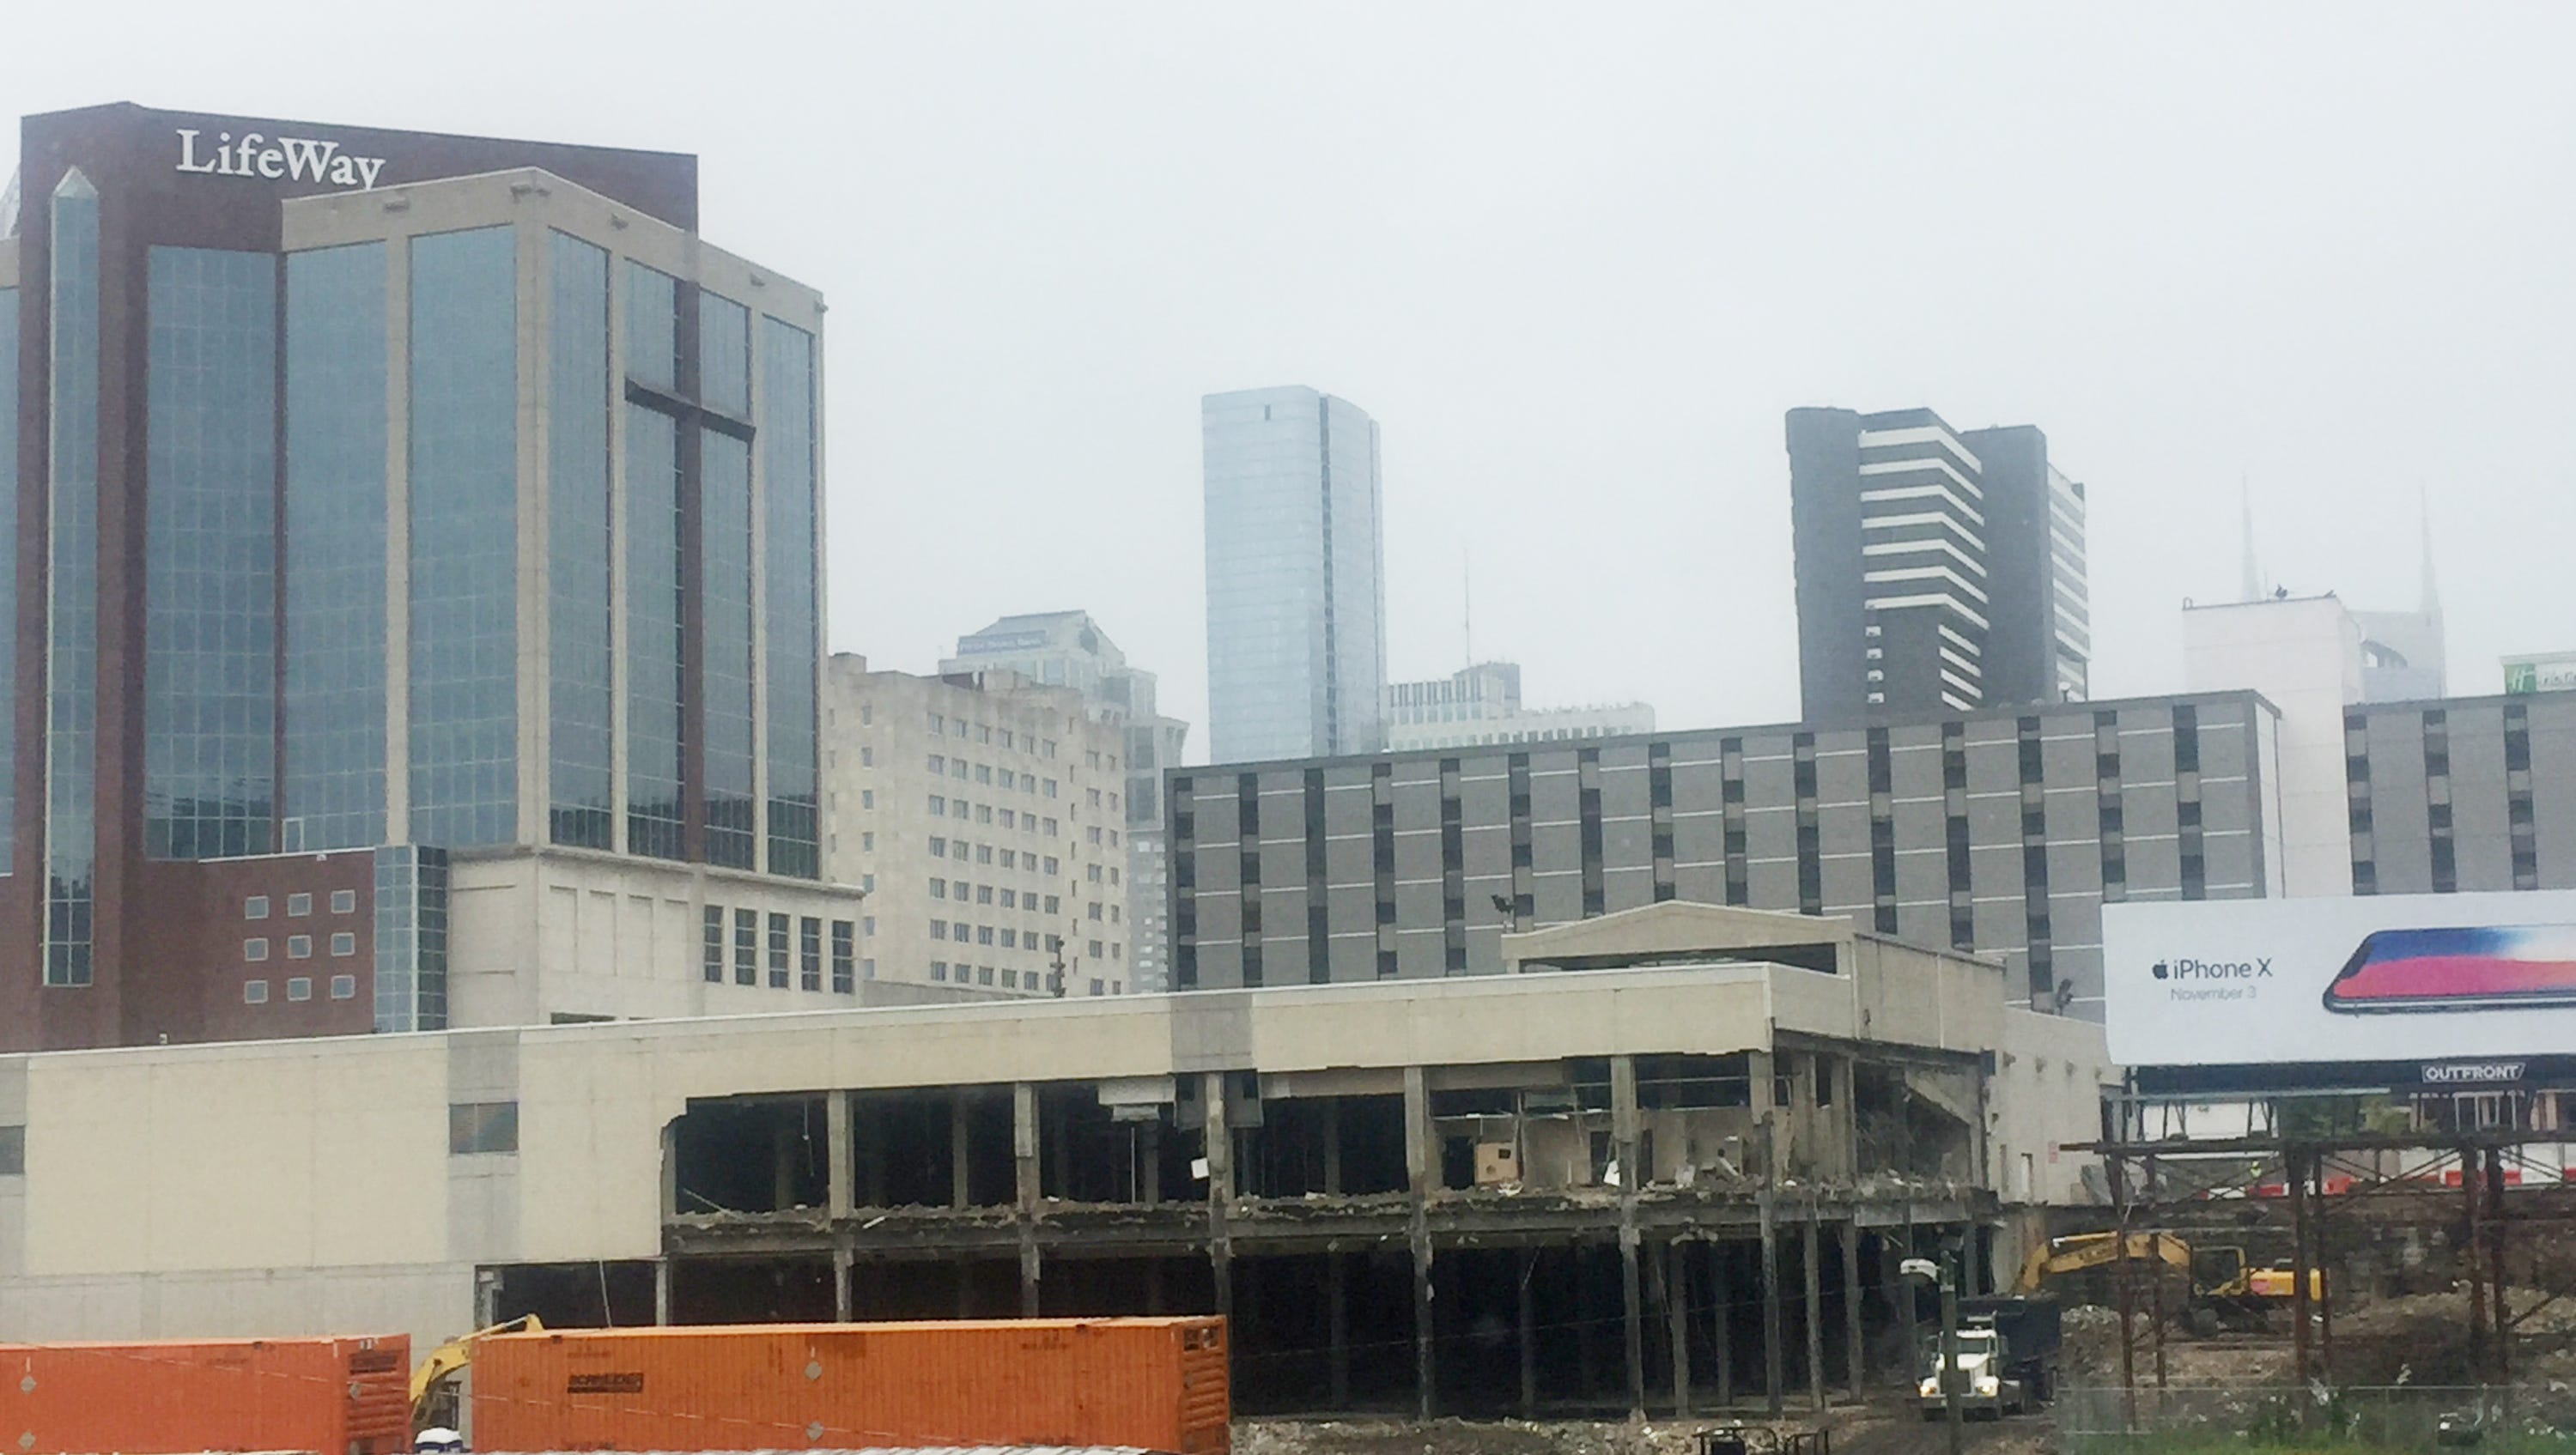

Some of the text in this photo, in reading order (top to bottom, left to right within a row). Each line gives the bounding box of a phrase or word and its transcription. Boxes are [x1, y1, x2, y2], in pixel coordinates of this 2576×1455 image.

[176, 129, 386, 191] LifeWay
[2173, 957, 2273, 979] iPhone X
[2171, 985, 2257, 1001] November 3
[2426, 1065, 2519, 1082] OUTFRONT
